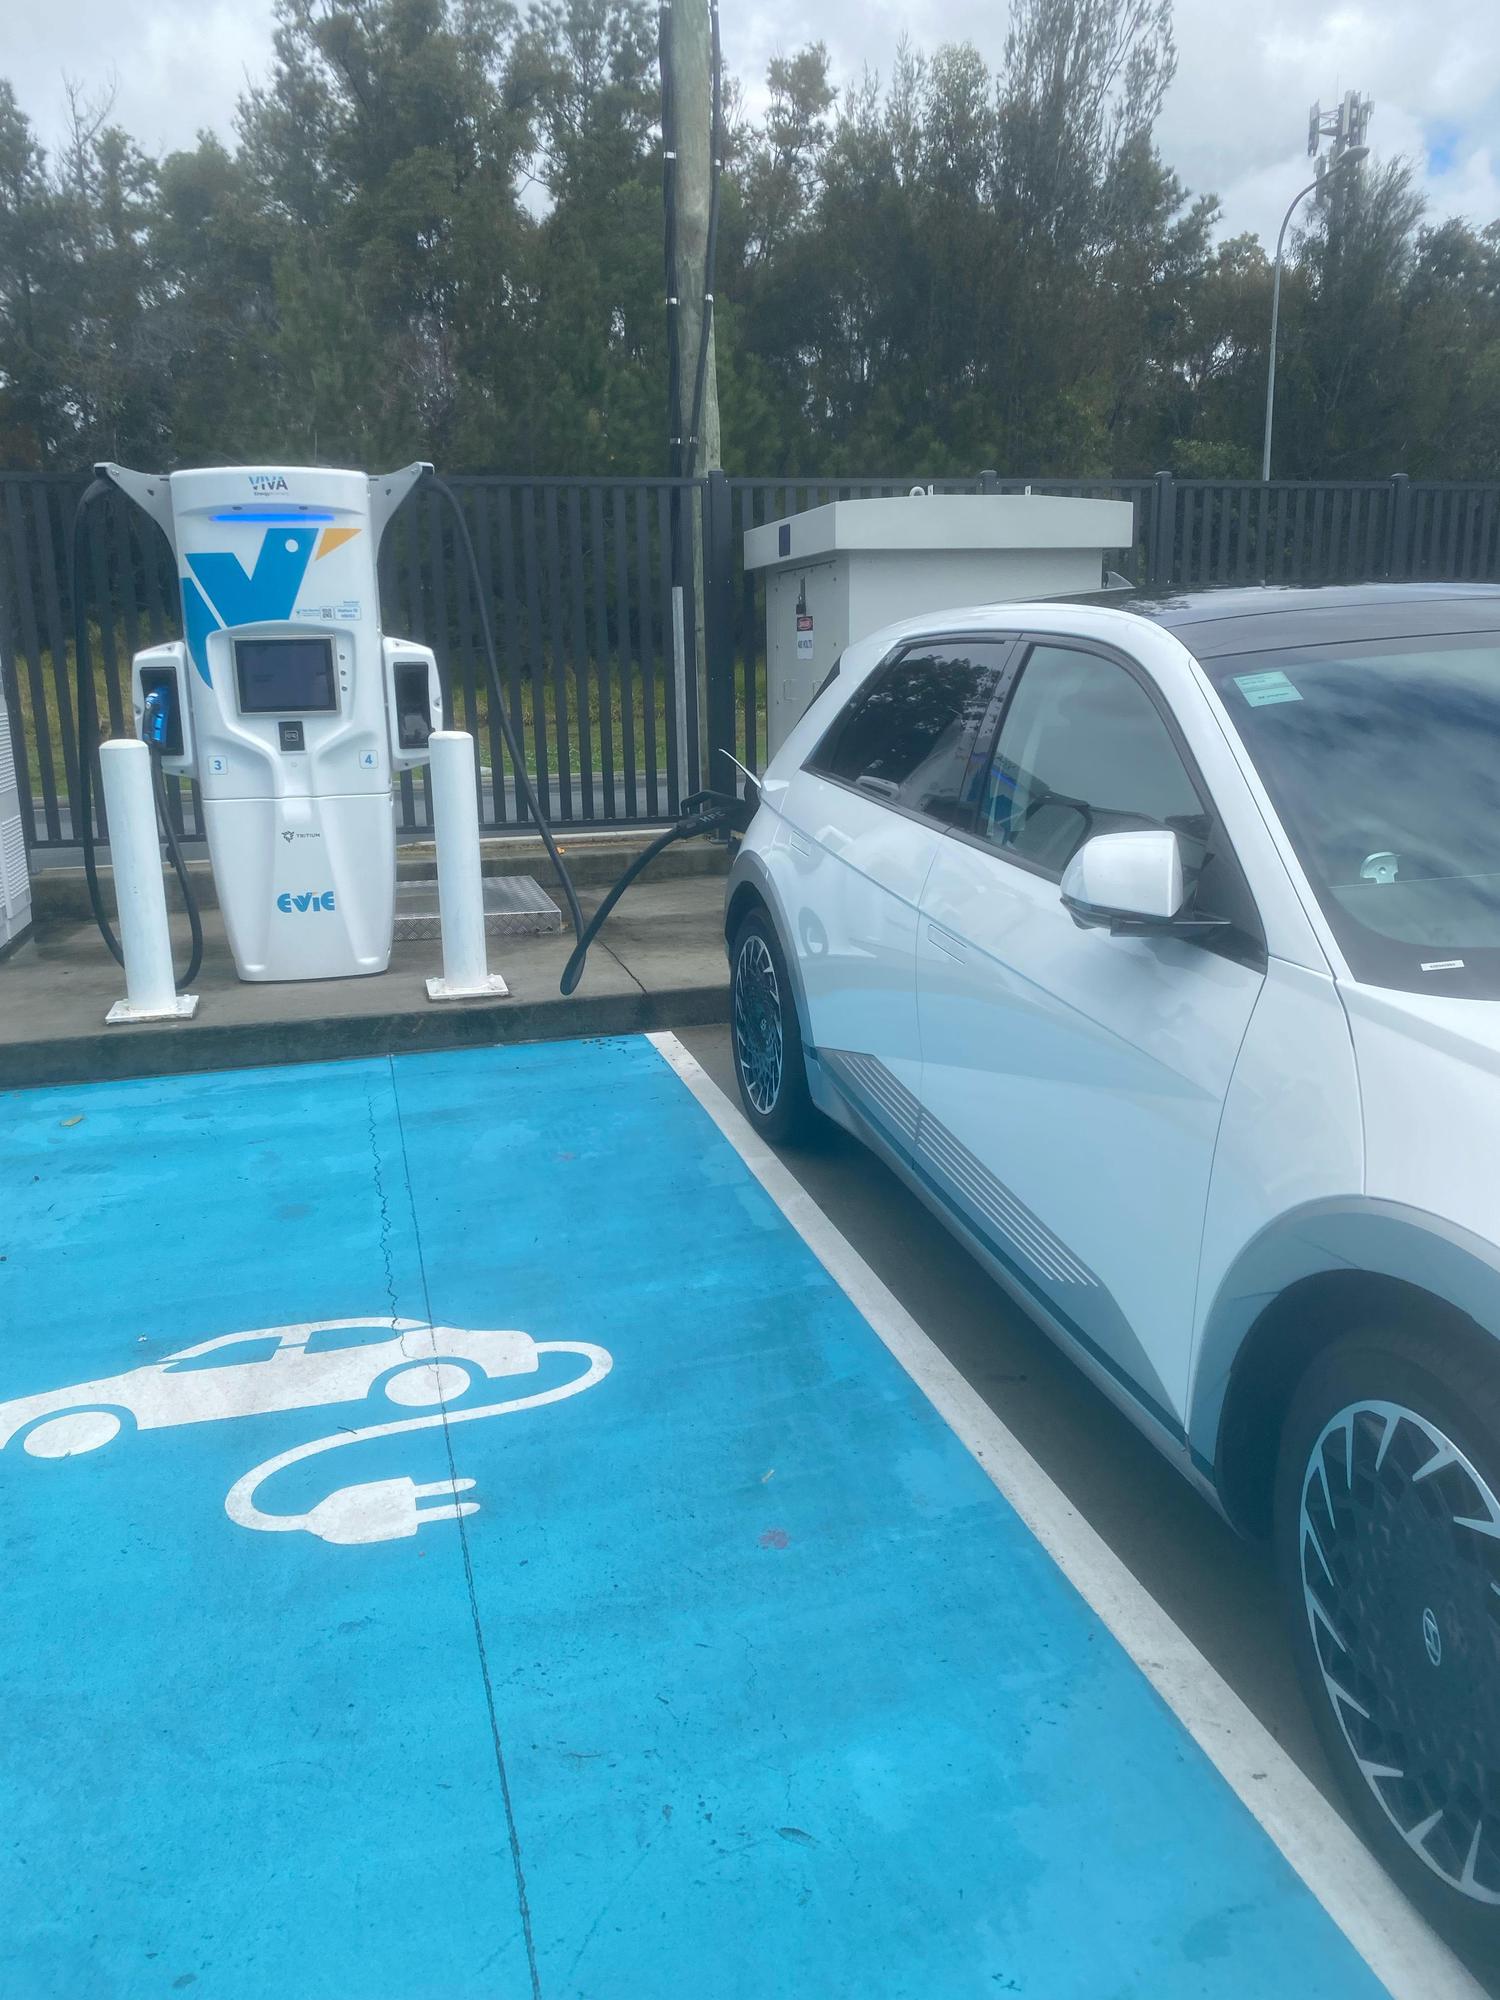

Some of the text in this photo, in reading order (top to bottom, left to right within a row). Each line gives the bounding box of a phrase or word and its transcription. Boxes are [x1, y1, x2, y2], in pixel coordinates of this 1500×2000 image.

[248, 476, 288, 490] VIVA
[214, 760, 222, 770] 3
[364, 754, 373, 765] 4
